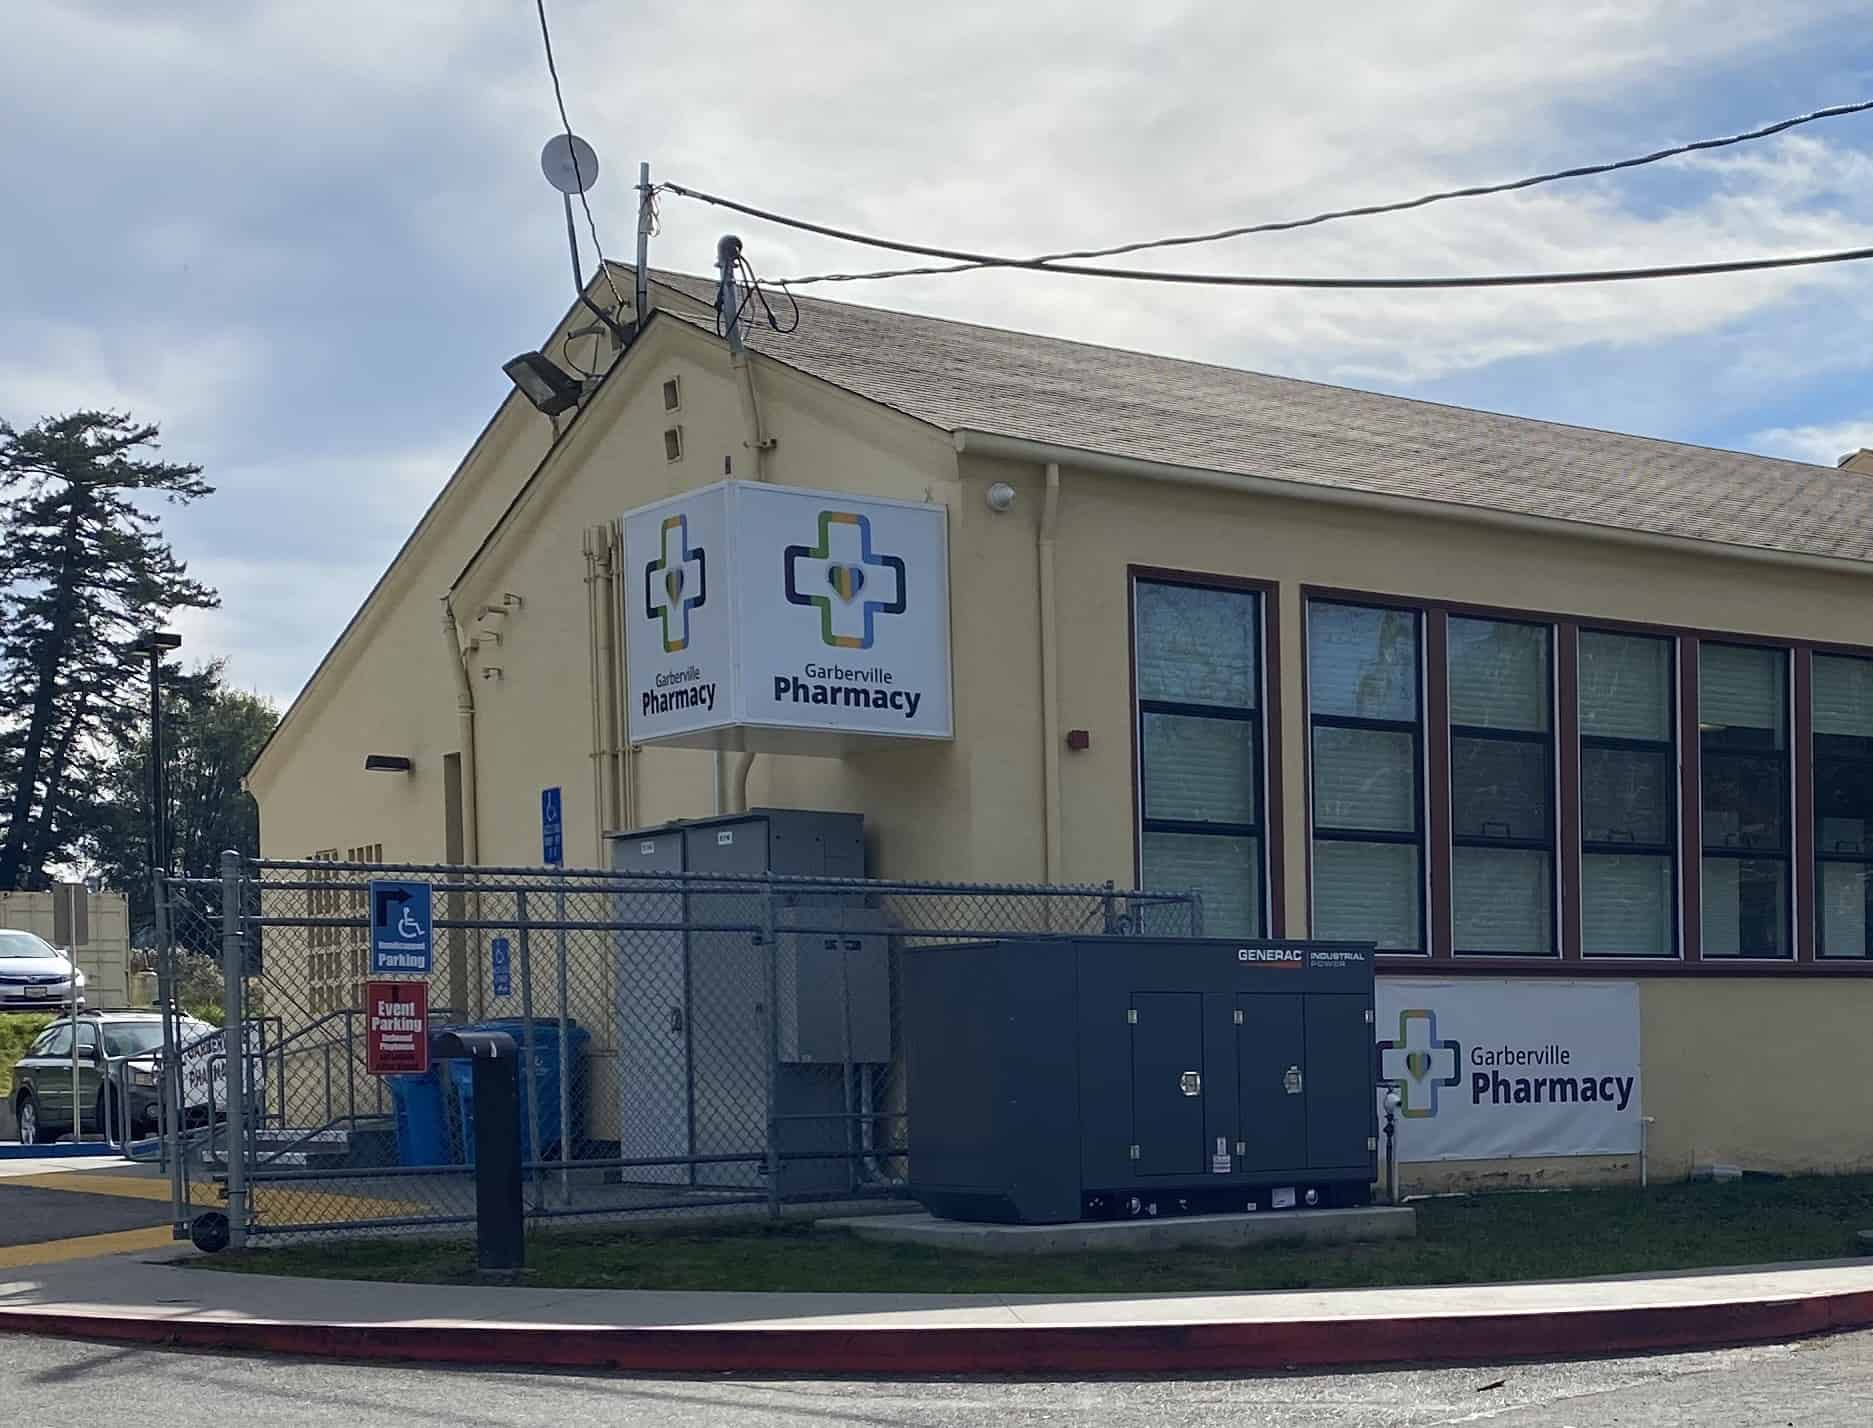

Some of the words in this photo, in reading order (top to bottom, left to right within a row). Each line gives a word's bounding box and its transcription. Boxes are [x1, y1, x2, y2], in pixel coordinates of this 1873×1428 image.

[656, 665, 701, 688] Garberville
[804, 663, 893, 685] Garberville
[642, 682, 716, 717] Pharmacy
[773, 676, 921, 718] Pharmacy
[378, 953, 425, 969] Parking
[1238, 949, 1303, 961] GENERAC
[1310, 952, 1365, 961] INDUSTRIAL
[378, 1001, 416, 1017] Event
[371, 1017, 423, 1033] Parking
[1470, 1045, 1571, 1066] Garberville
[1471, 1070, 1634, 1111] Pharmacy
